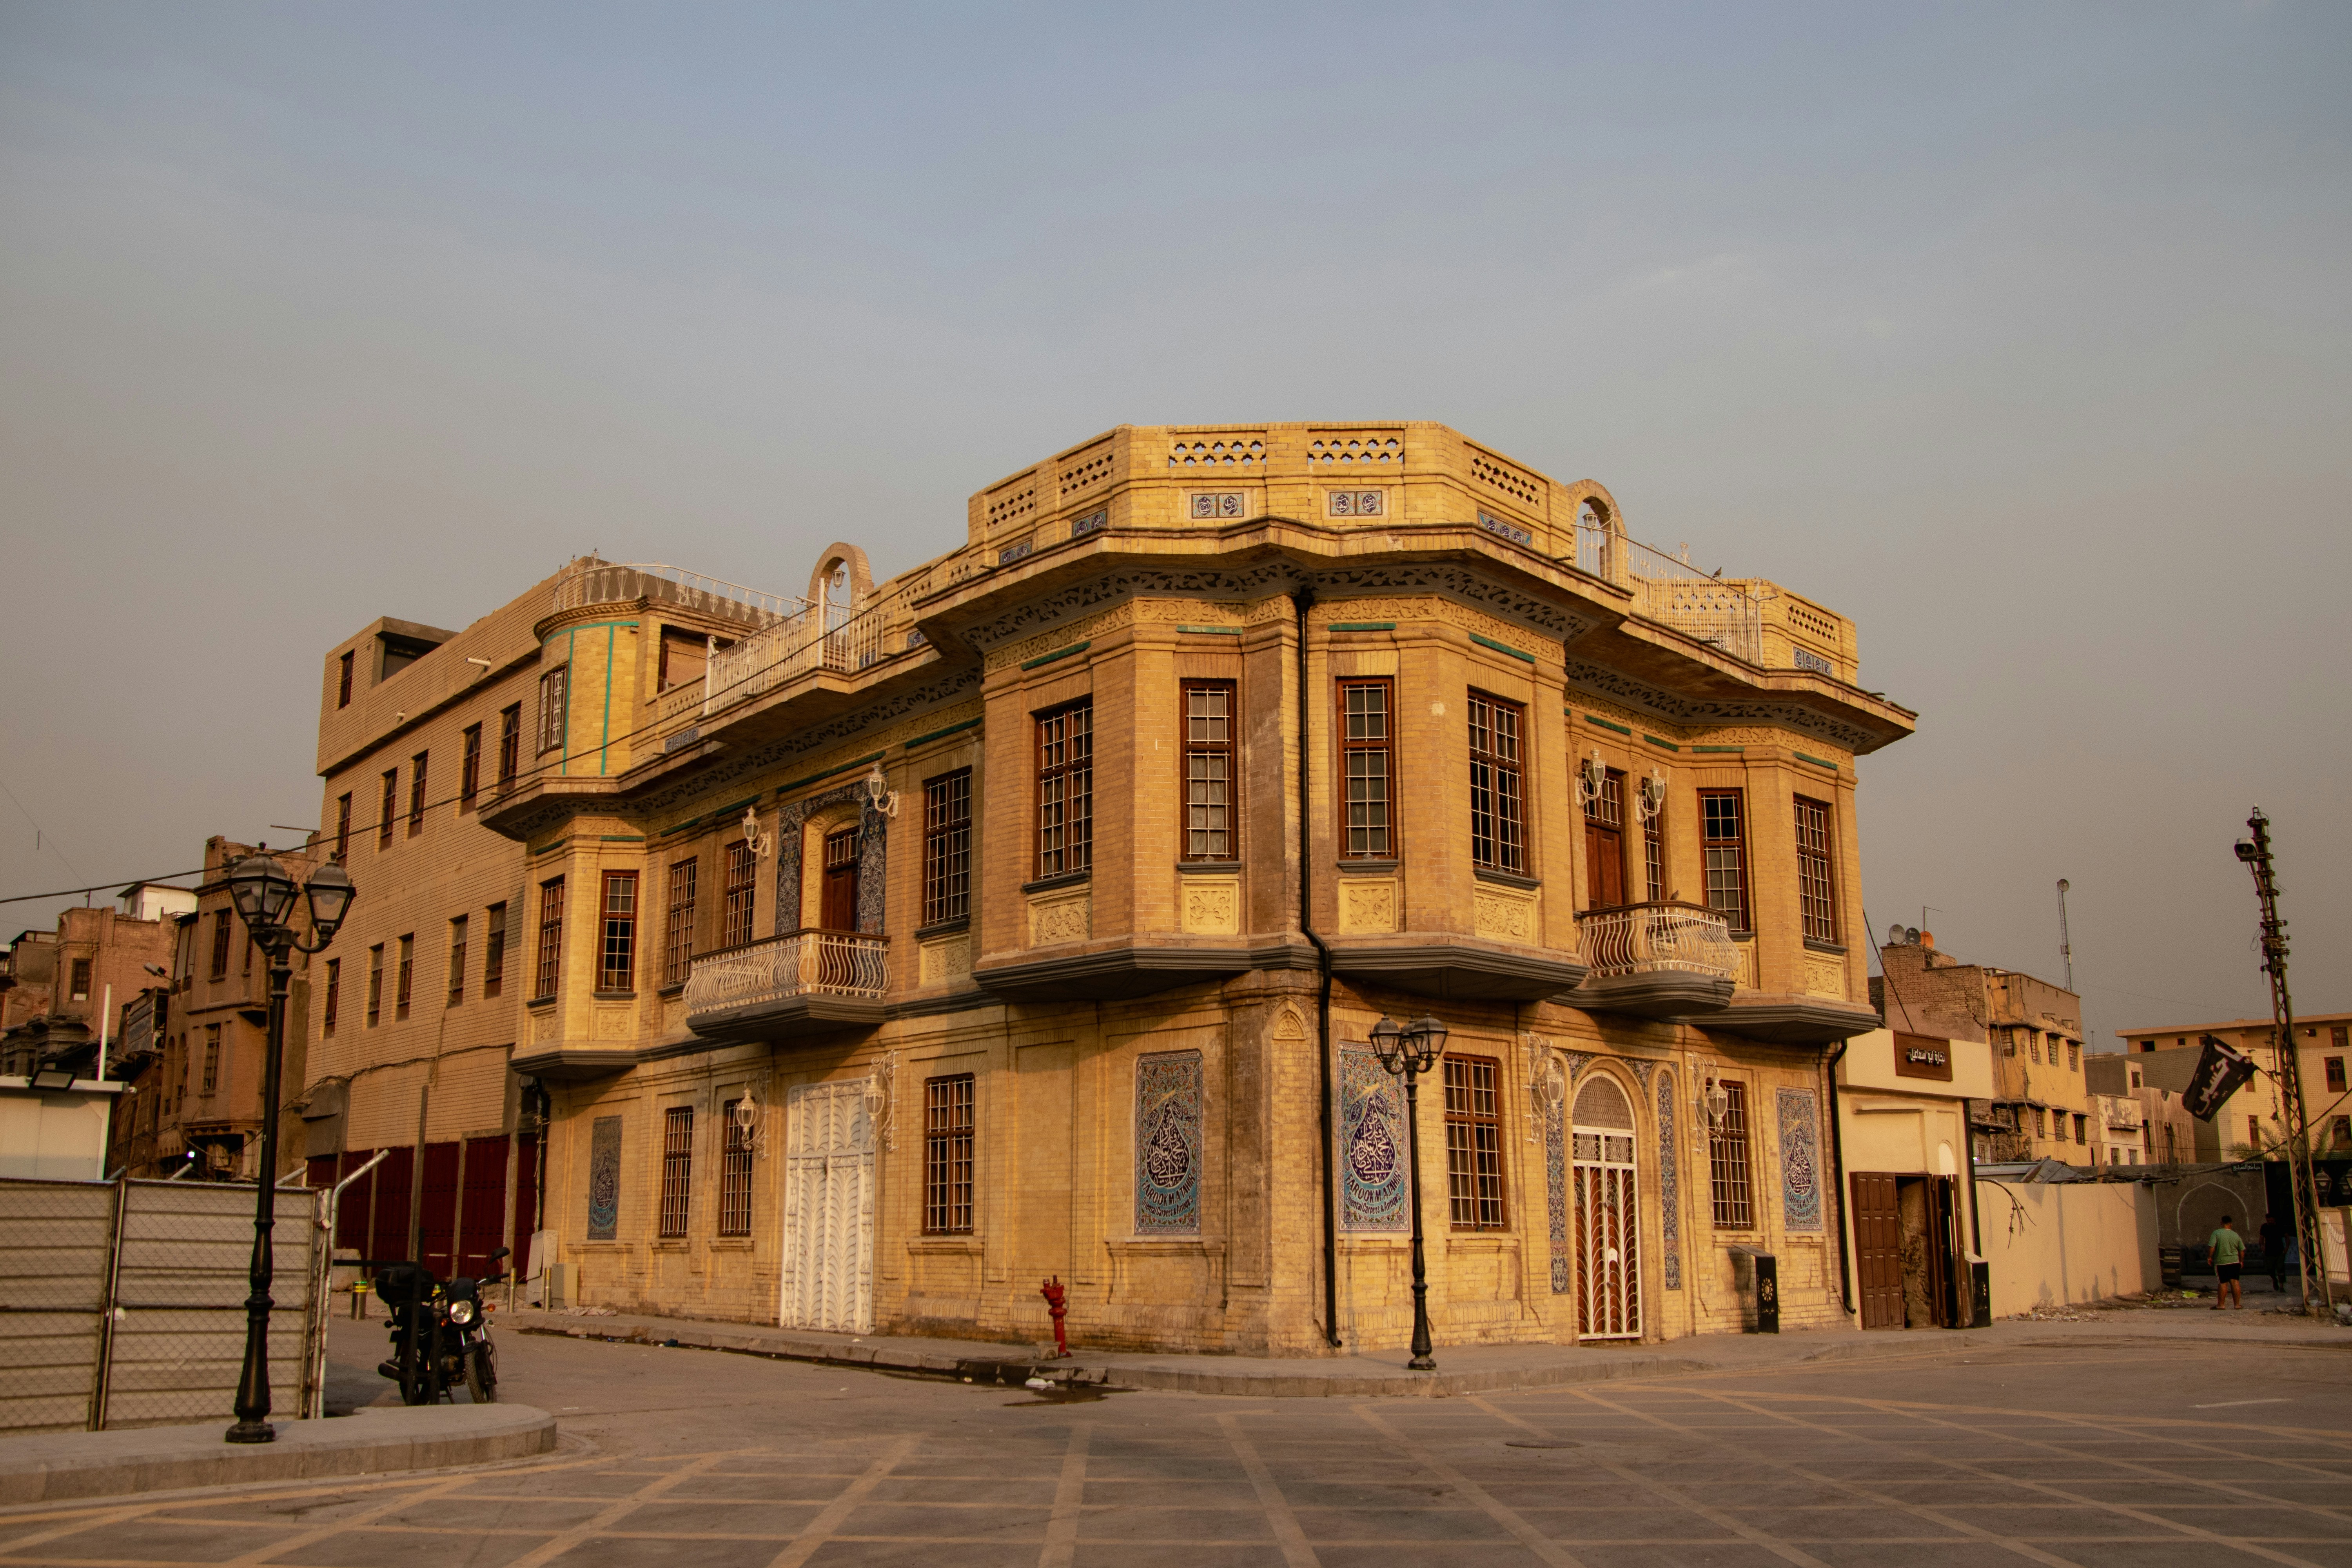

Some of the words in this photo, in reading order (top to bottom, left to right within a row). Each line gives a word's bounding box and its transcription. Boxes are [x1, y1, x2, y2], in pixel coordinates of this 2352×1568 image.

[1142, 1180, 1167, 1207] FAROOK
[1179, 1173, 1195, 1198] TAHIR
[1345, 1173, 1374, 1203] FAROOK
[1387, 1171, 1402, 1195] TAHIR
[1142, 1197, 1156, 1214] Oriental
[1156, 1206, 1172, 1217] Carpets
[1345, 1192, 1363, 1212] Oriental
[1362, 1203, 1379, 1214] Carpets
[1381, 1205, 1384, 1213] &
